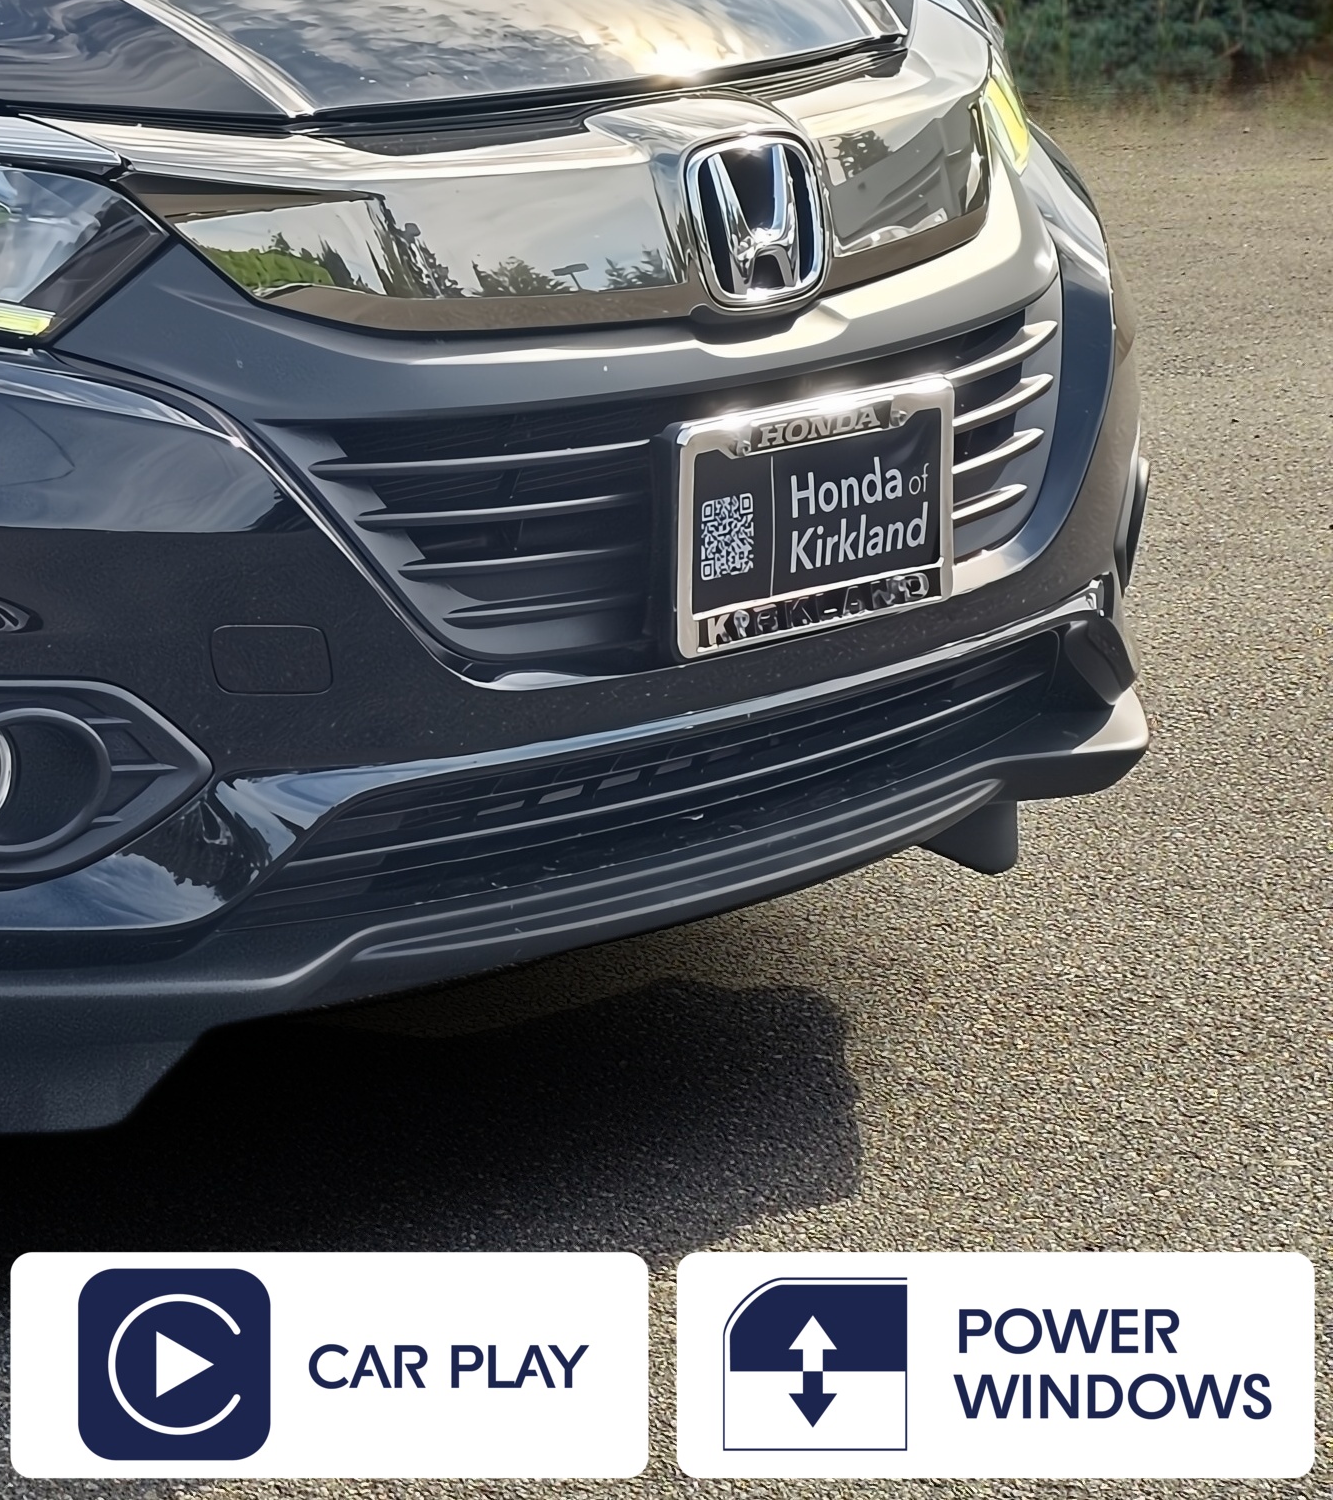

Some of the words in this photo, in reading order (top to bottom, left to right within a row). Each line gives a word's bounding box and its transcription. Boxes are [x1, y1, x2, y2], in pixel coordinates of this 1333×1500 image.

[756, 406, 882, 449] HONDA
[789, 456, 904, 519] Honda
[907, 462, 930, 496] of
[789, 500, 930, 574] Kirkland
